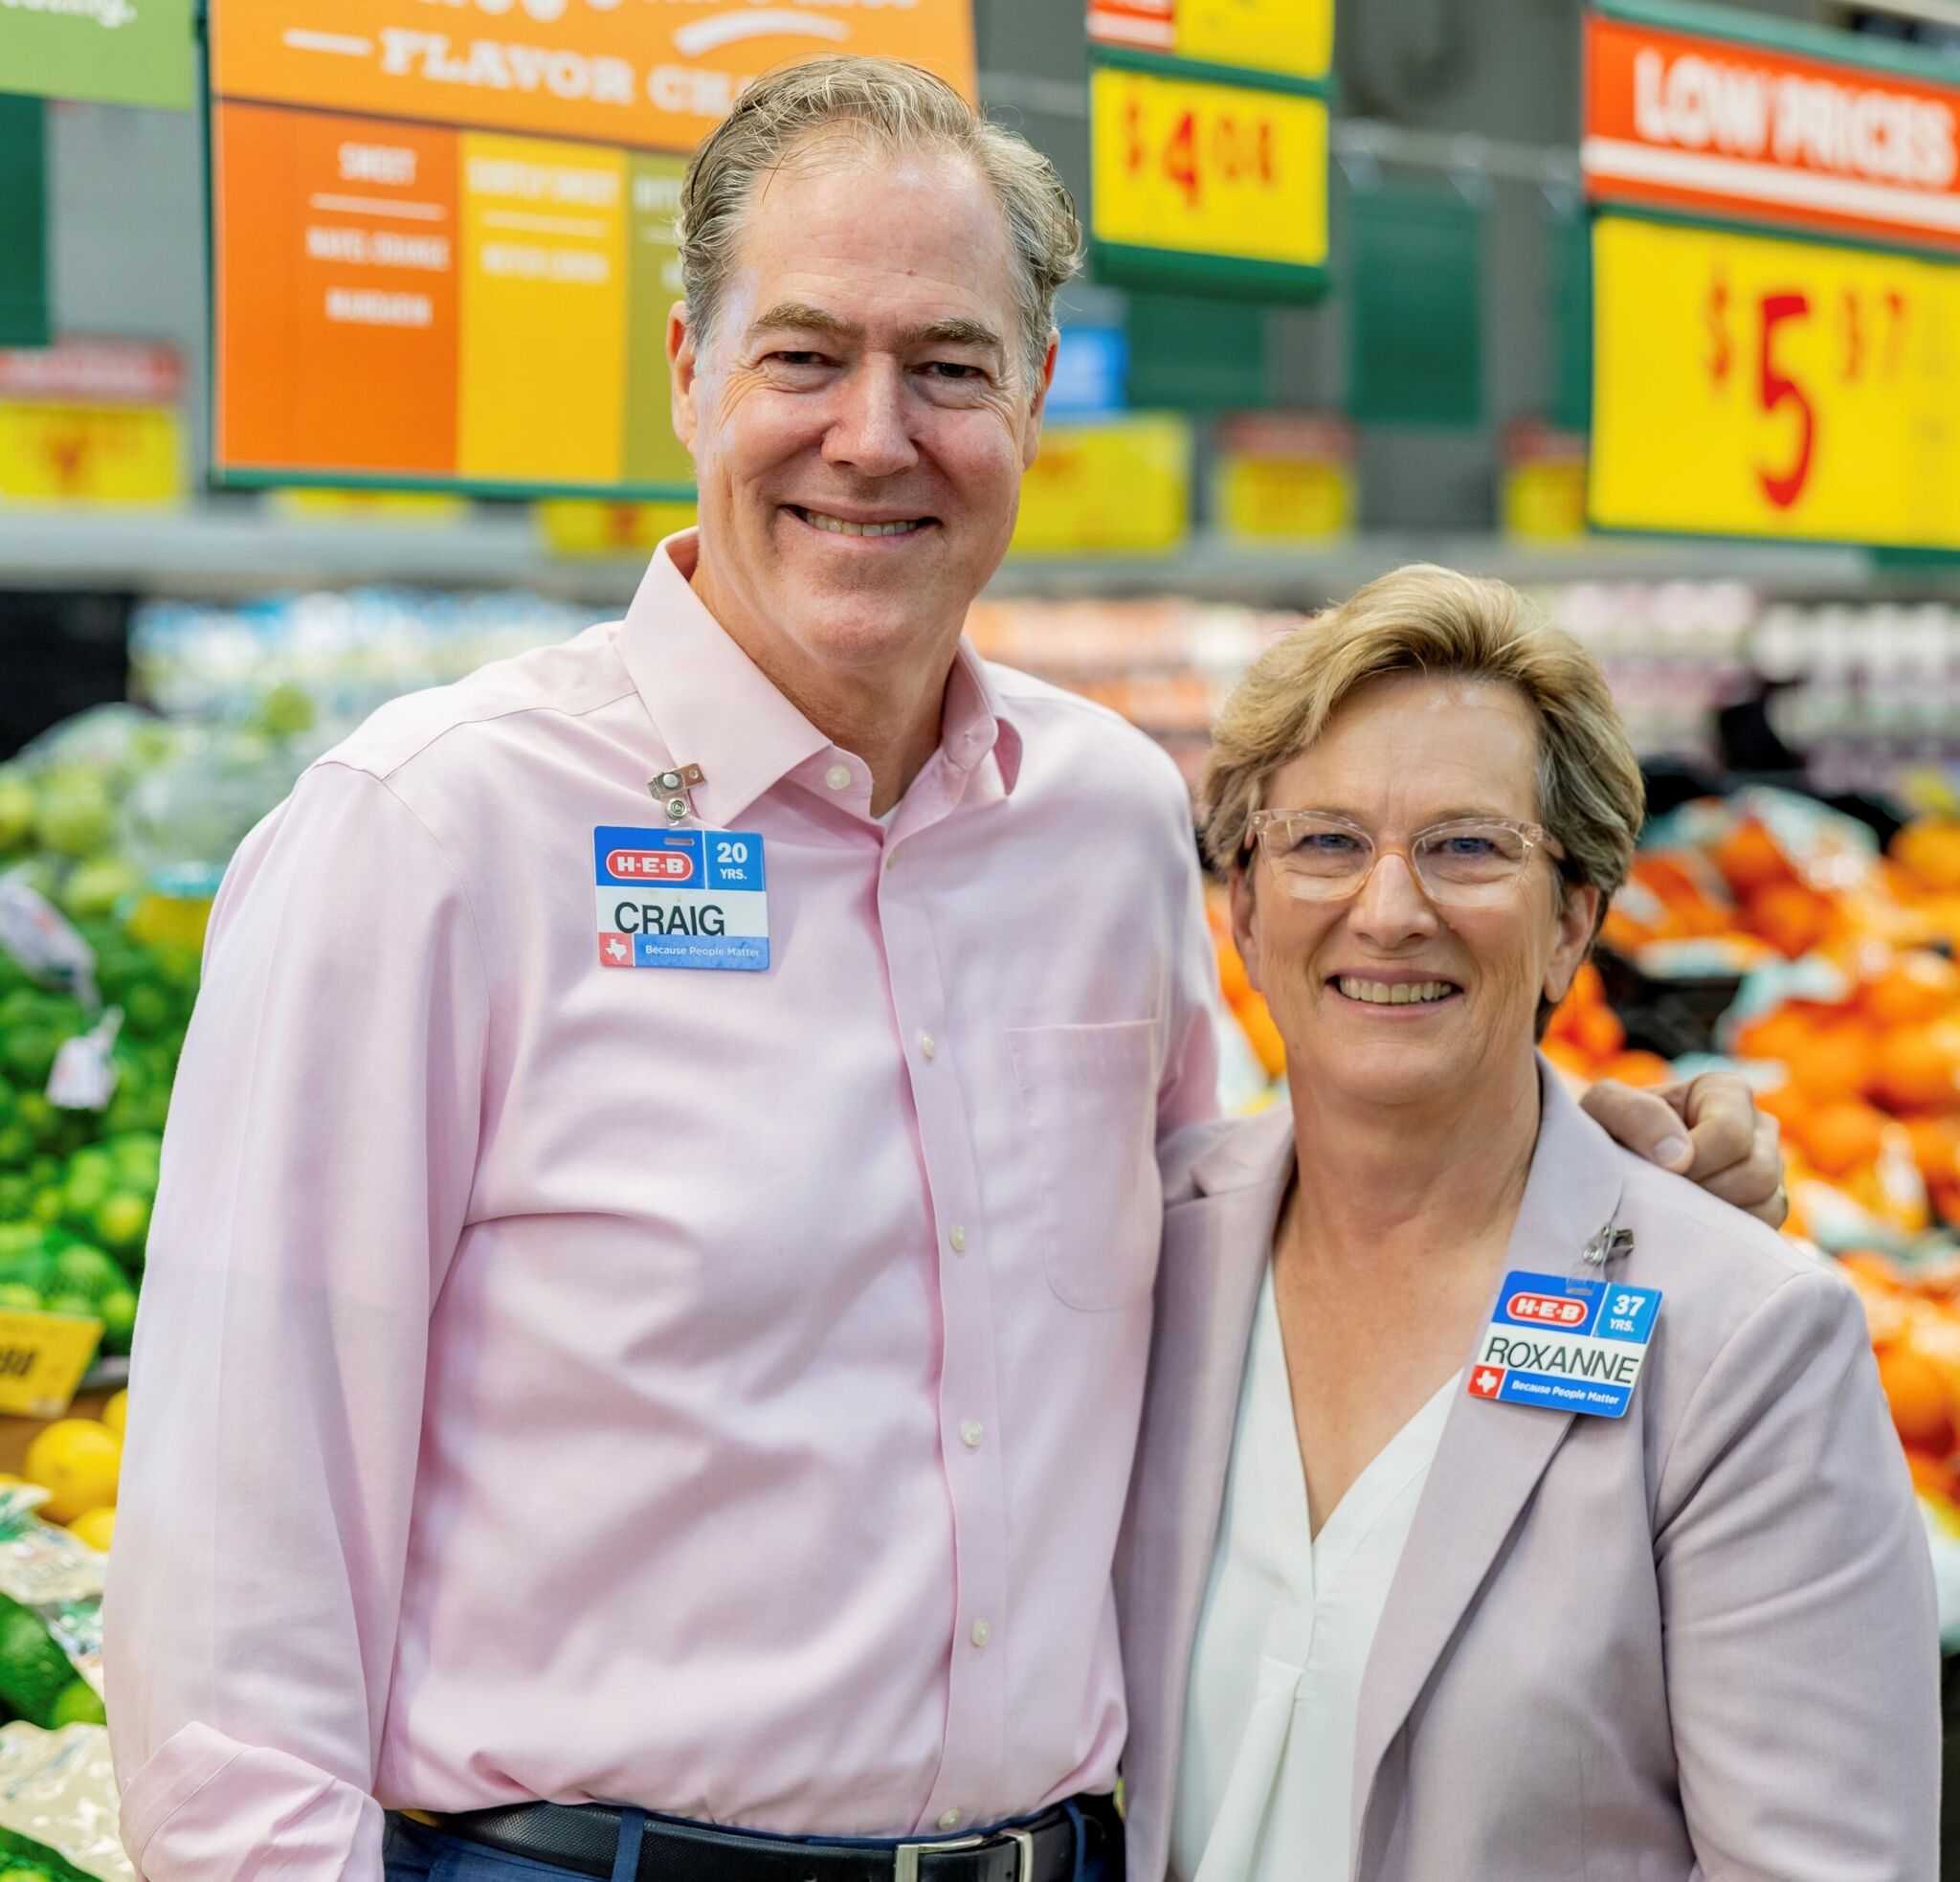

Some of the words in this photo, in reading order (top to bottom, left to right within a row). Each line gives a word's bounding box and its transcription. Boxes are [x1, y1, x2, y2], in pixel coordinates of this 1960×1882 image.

[379, 27, 635, 105] FLAVOR
[1634, 48, 1770, 158] LOW
[1772, 75, 1957, 190] PRICES
[717, 842, 747, 863] 20
[720, 868, 746, 880] YRS.
[614, 902, 724, 936] CRAIG
[645, 945, 687, 955] Because
[690, 947, 724, 958] People
[727, 948, 759, 957] Matter
[1613, 1294, 1645, 1316] 37
[1610, 1318, 1635, 1332] YRS.
[1484, 1336, 1639, 1384] ROXANNE
[1511, 1379, 1550, 1395] Because
[1552, 1386, 1585, 1400] People
[1587, 1391, 1620, 1405] Matter
